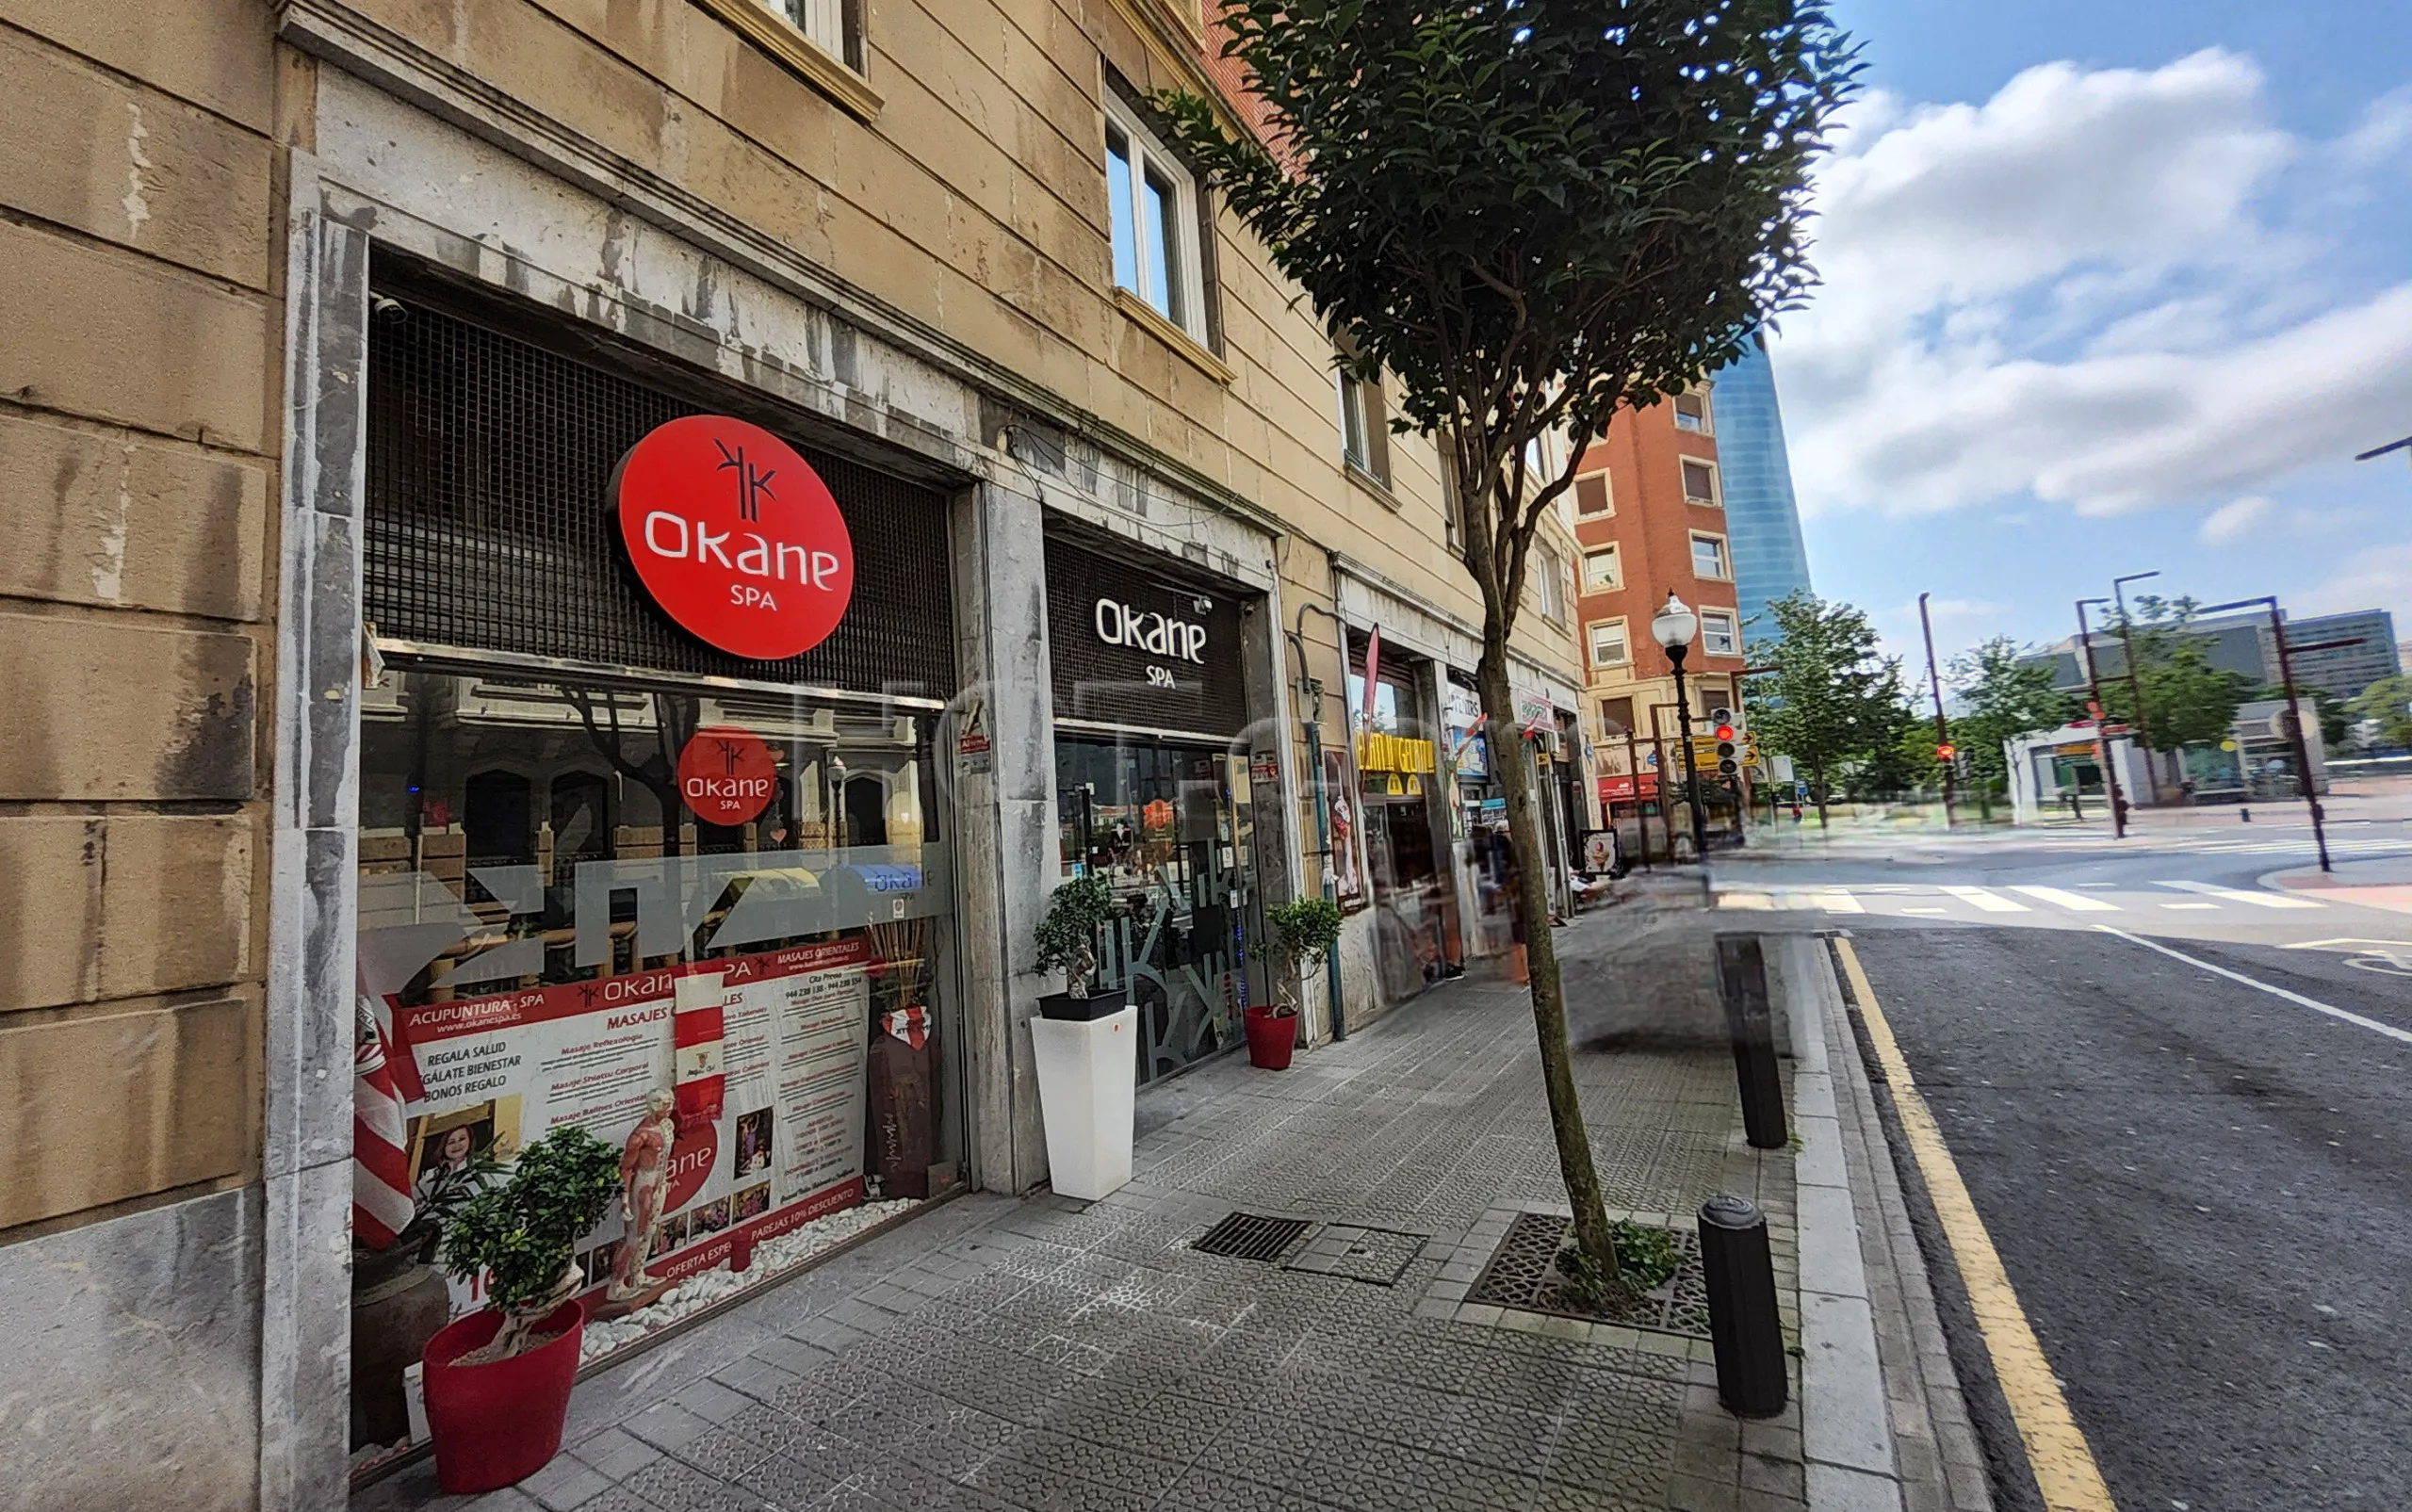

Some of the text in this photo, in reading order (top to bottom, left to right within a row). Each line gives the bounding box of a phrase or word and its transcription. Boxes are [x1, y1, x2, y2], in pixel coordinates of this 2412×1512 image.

[644, 512, 839, 592] Okane
[730, 584, 777, 611] SPA
[1096, 597, 1207, 664] Okane
[1145, 664, 1176, 690] SPA
[686, 777, 769, 798] Okane
[720, 800, 742, 810] SPA
[777, 949, 814, 965] MASAJES
[604, 973, 673, 1000] Okan
[409, 1000, 511, 1027] ACUPUNTURA
[520, 993, 545, 1009] SPA
[607, 1007, 667, 1030] MASAJES
[427, 1041, 507, 1066] REGALA SALUD
[467, 1055, 522, 1076] BIENESTAR
[424, 1075, 507, 1103] BONOS REGALO
[665, 1146, 711, 1178] ane
[666, 1254, 707, 1278] OFERTA
[751, 1218, 790, 1241] PAREJAS
[808, 1188, 855, 1216] DESCUENTO
